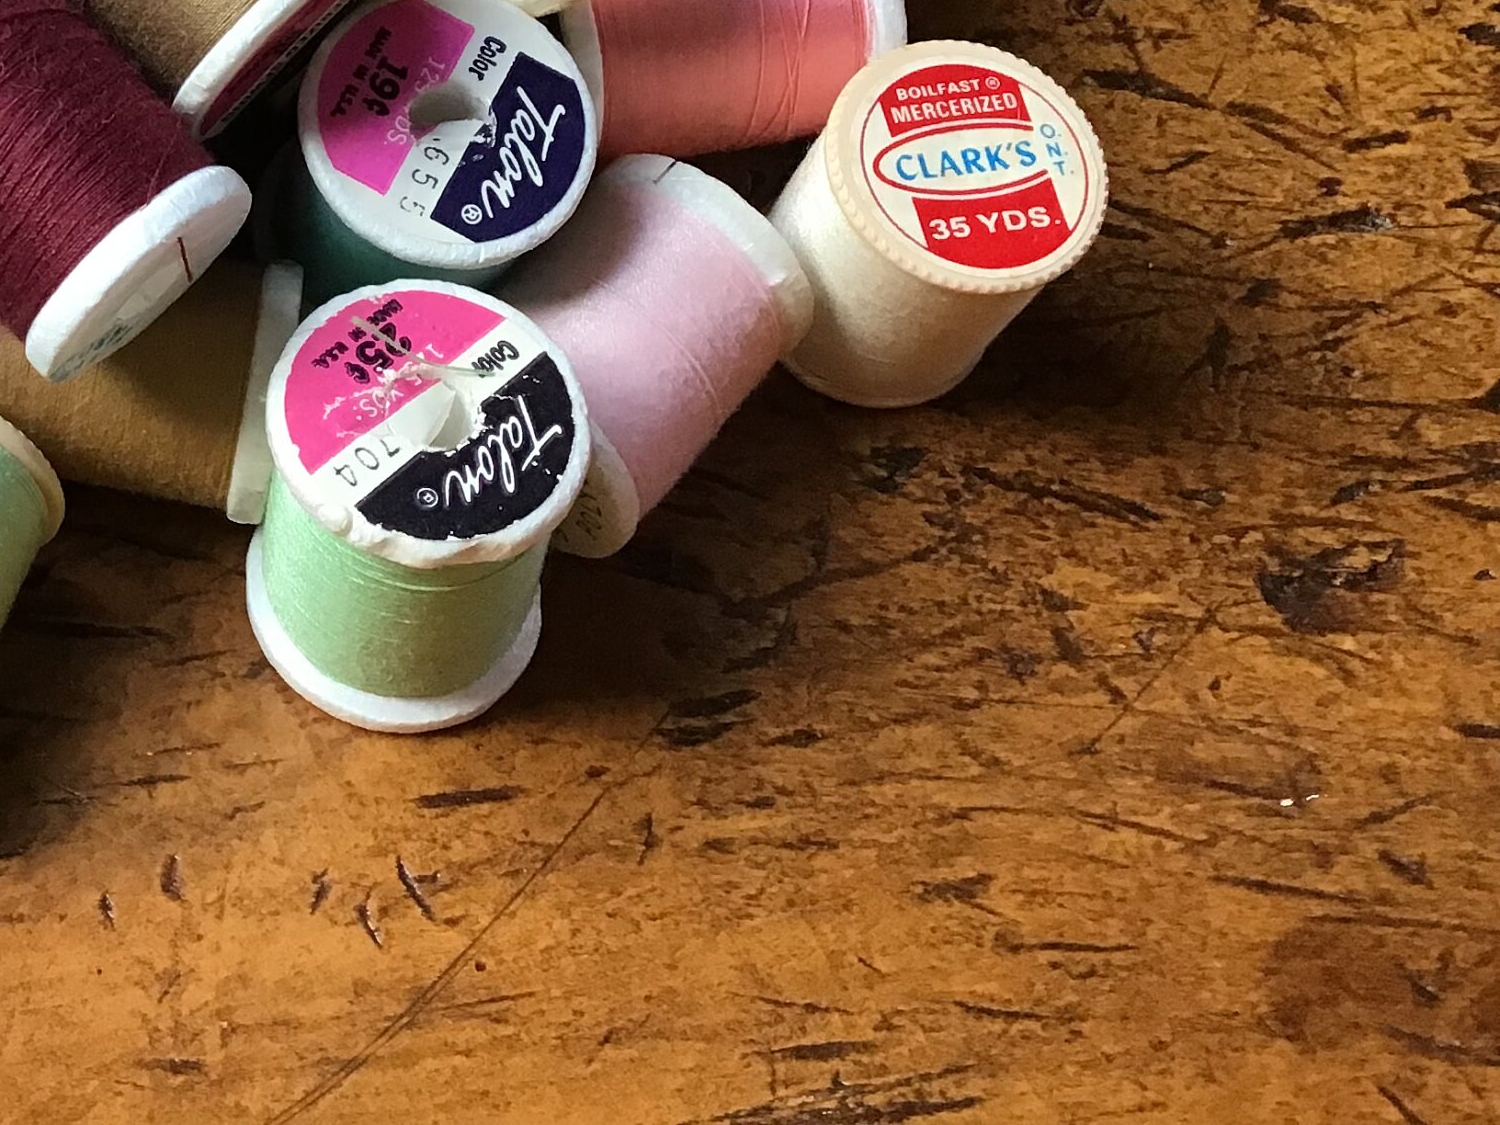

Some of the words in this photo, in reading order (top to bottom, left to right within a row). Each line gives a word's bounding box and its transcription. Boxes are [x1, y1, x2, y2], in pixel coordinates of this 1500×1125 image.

[468, 35, 508, 81] Color
[895, 78, 981, 101] BOILFAST
[890, 92, 1018, 124] MERCERIZED
[896, 140, 1036, 181] CLARK'S
[929, 216, 971, 240] 35
[976, 206, 1062, 234] YDS.
